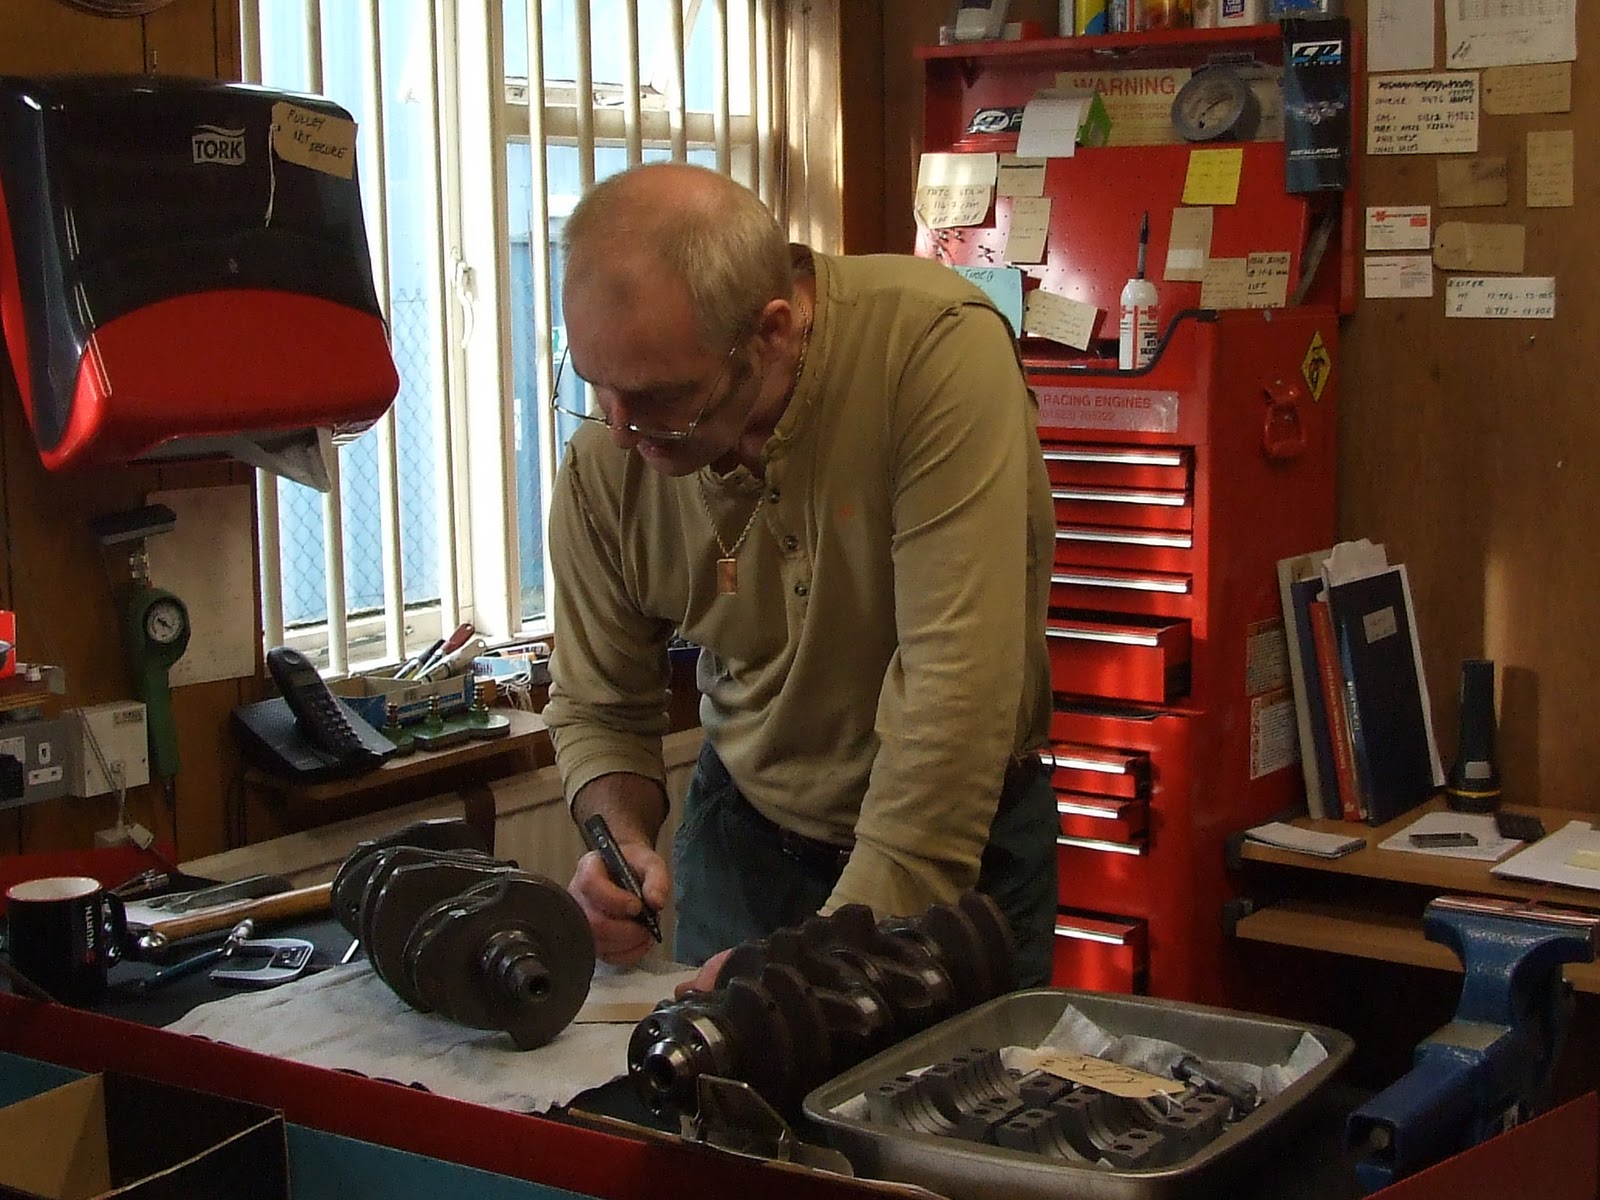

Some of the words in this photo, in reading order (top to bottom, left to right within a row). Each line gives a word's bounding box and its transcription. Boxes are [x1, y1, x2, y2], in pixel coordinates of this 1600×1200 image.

[1073, 76, 1175, 96] WARNING
[194, 139, 242, 159] TORK
[1042, 394, 1091, 407] RACING
[1095, 396, 1152, 409] ENGINES
